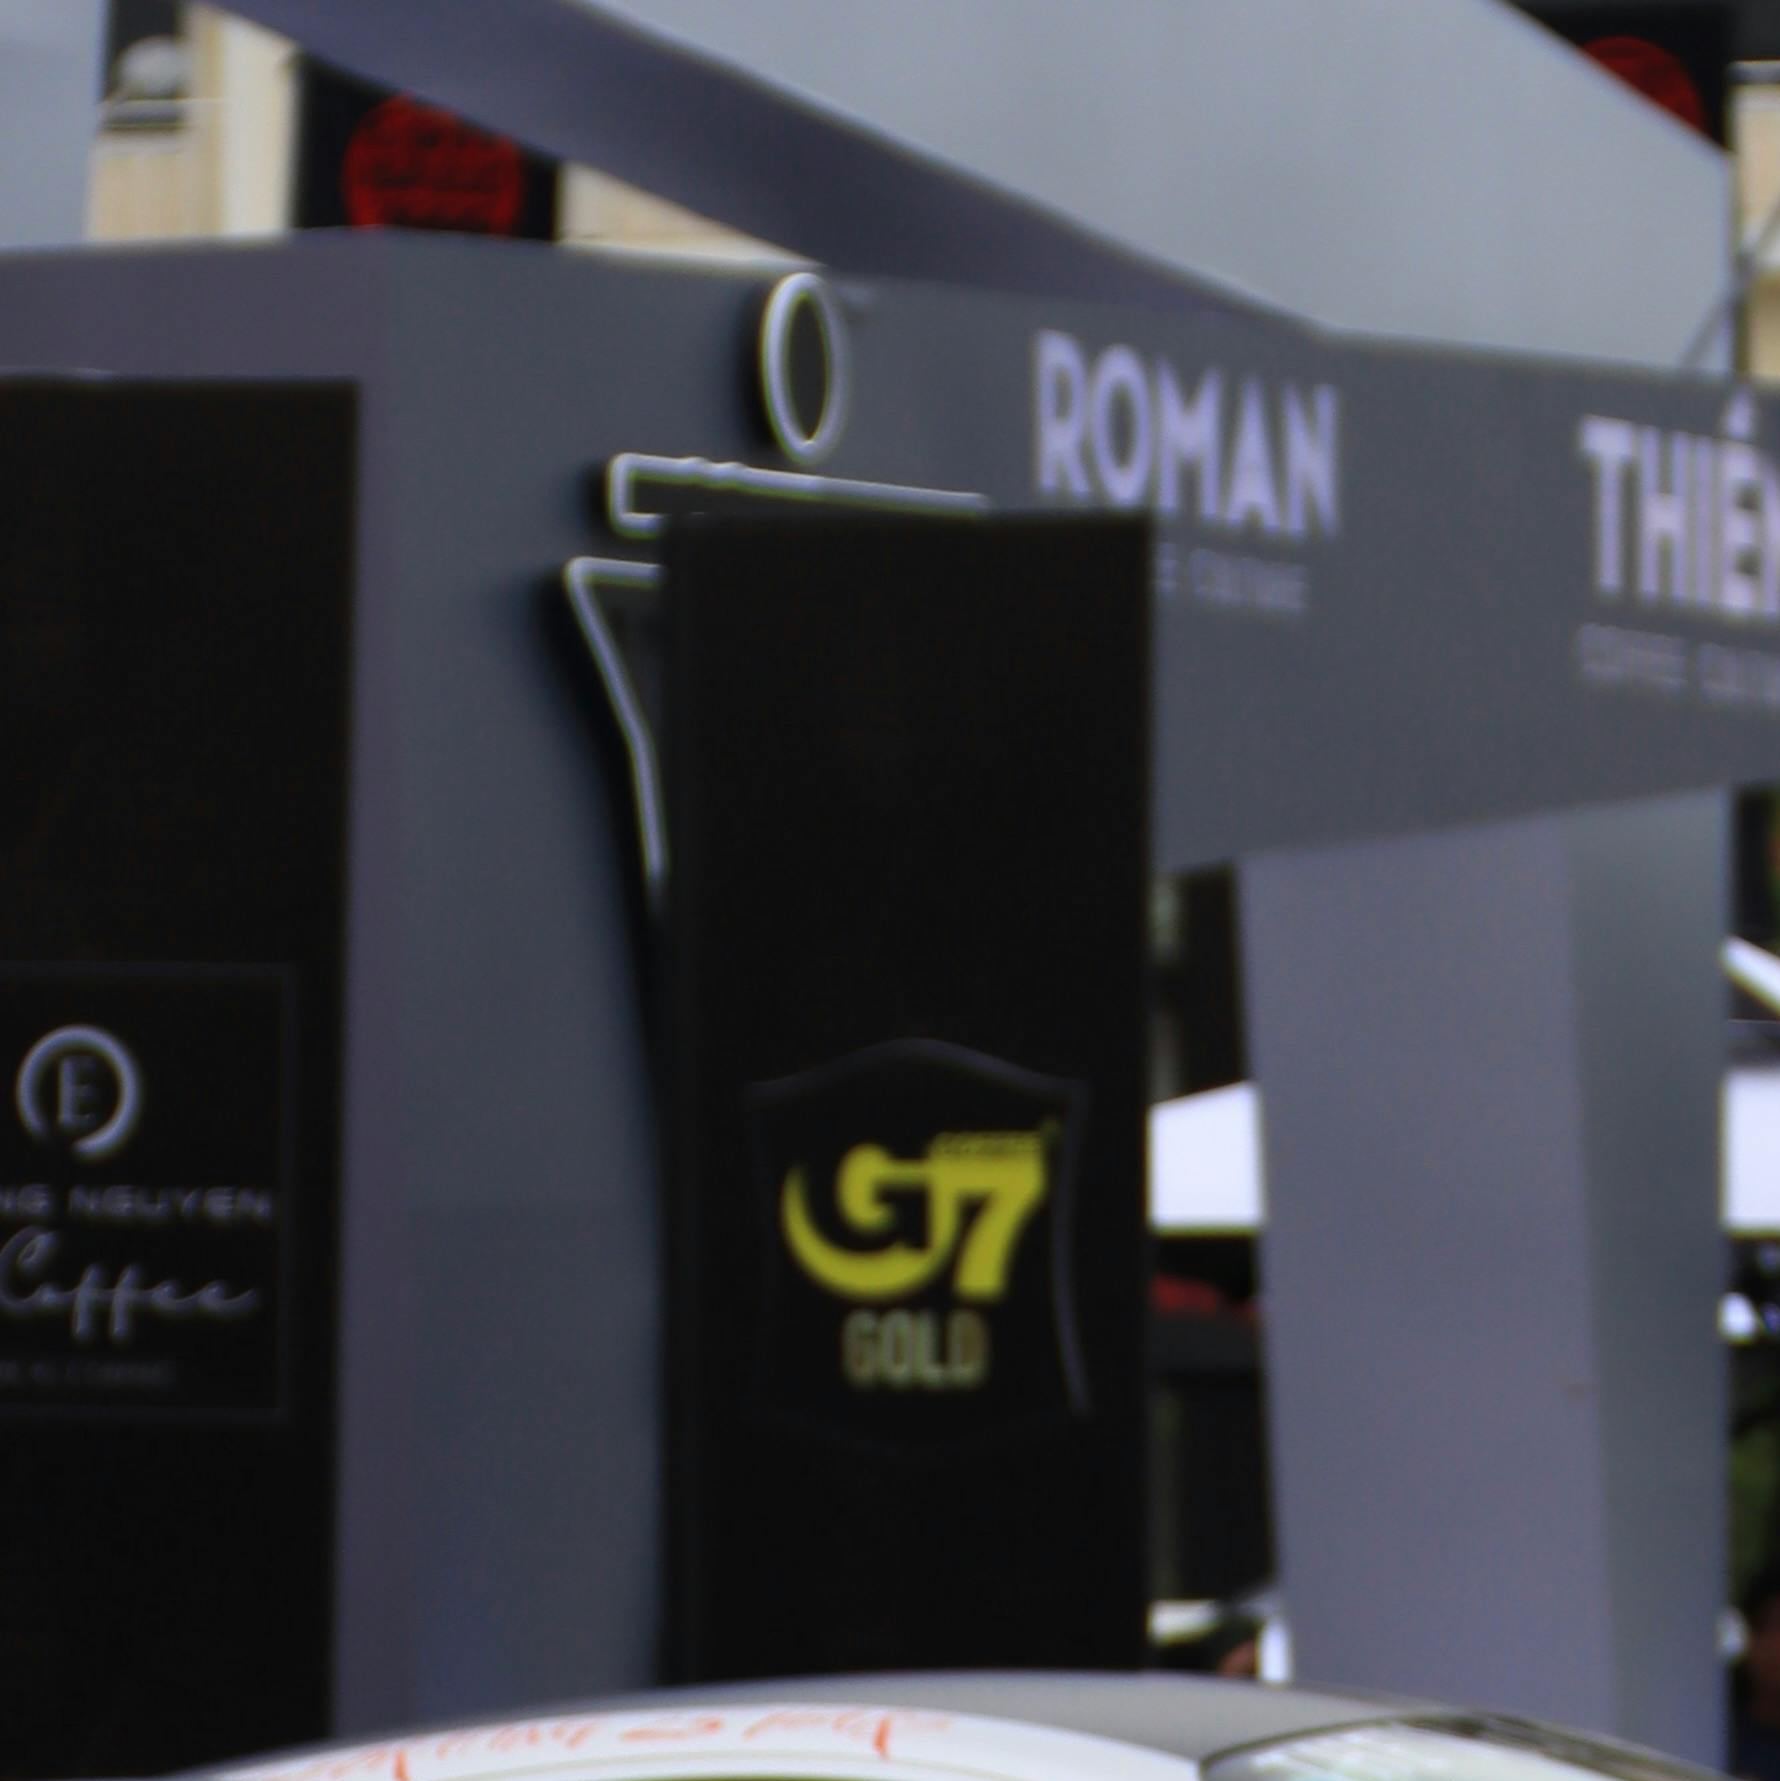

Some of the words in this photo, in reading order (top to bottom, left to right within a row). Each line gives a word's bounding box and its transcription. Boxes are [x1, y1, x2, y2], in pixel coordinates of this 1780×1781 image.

[1032, 328, 1341, 537] ROMAN
[0, 1225, 259, 1344] Coffee
[780, 1142, 1048, 1304] G7
[841, 1309, 990, 1390] GOLD
